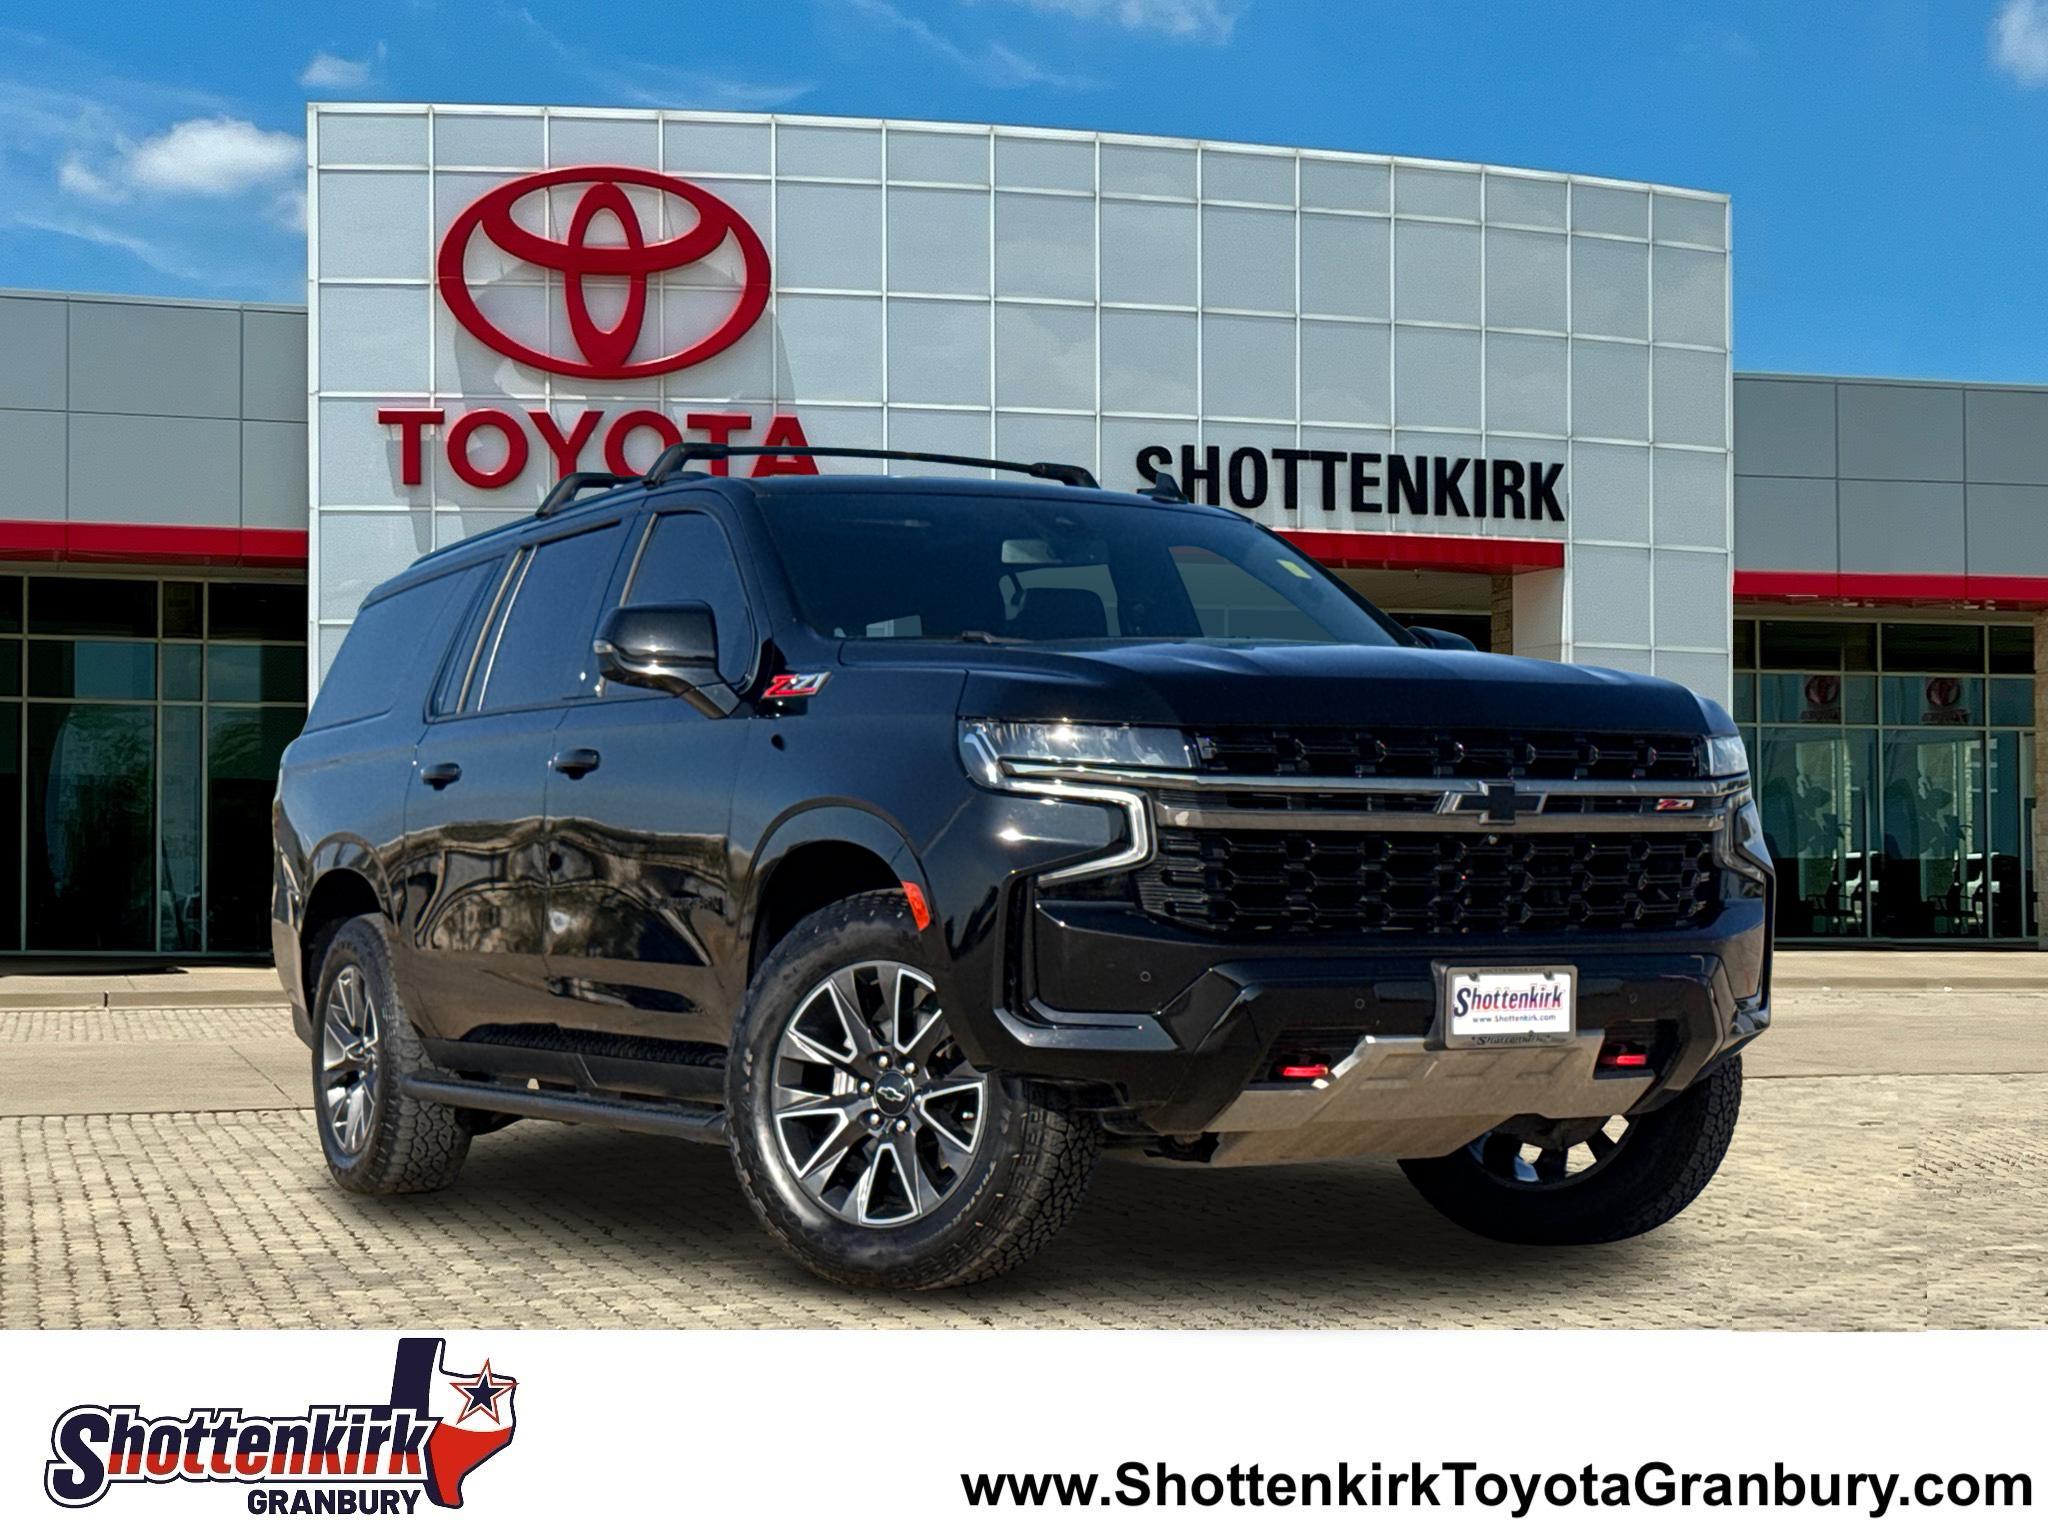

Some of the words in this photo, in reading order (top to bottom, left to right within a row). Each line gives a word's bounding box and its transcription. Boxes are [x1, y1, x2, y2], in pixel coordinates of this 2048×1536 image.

[377, 407, 820, 489] TOYOTA
[1136, 444, 1565, 522] SHOTTENKIRK
[1453, 984, 1564, 1017] Shottenkirk
[1472, 1013, 1556, 1023] wwwShottenkirk.com
